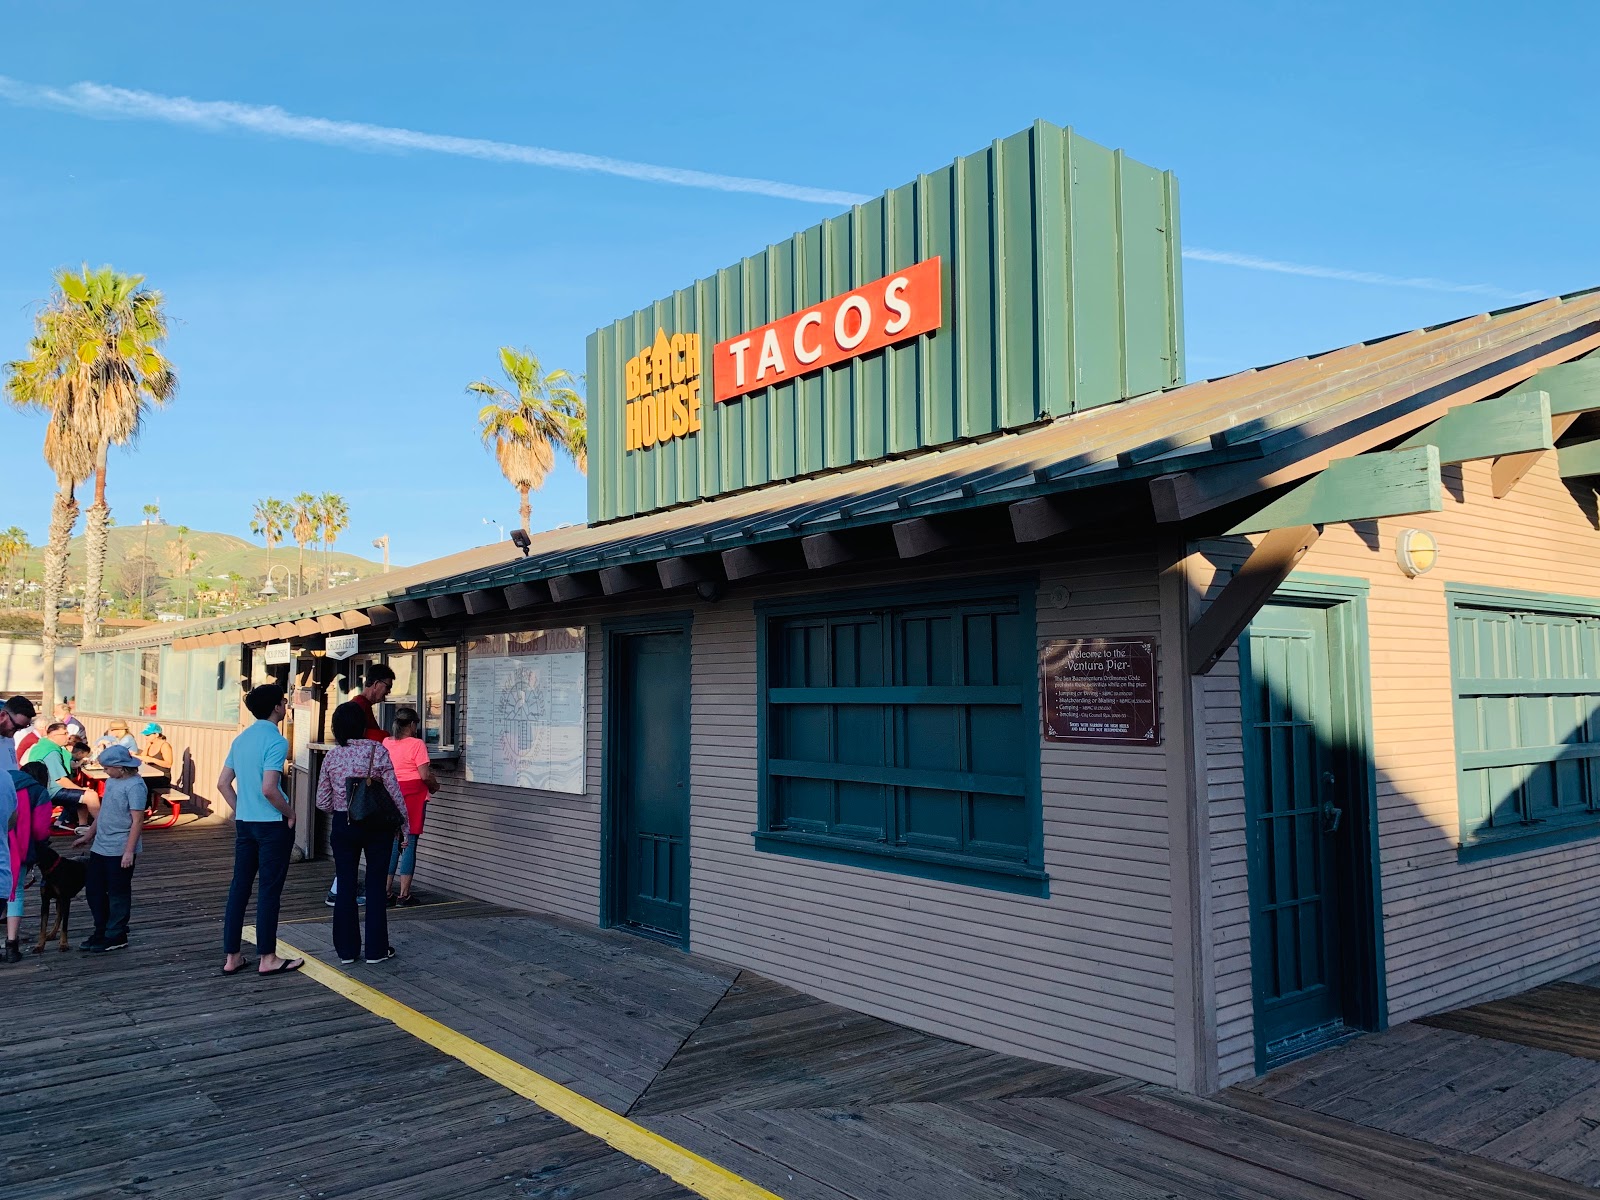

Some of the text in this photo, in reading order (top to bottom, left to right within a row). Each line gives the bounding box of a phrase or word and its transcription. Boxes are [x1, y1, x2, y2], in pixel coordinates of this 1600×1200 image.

[729, 276, 912, 388] TACOS
[625, 326, 700, 402] BEACH
[626, 380, 701, 452] HOUSE
[342, 638, 355, 649] HERE
[543, 631, 577, 651] TACOS
[1067, 648, 1126, 659] Welcome to the
